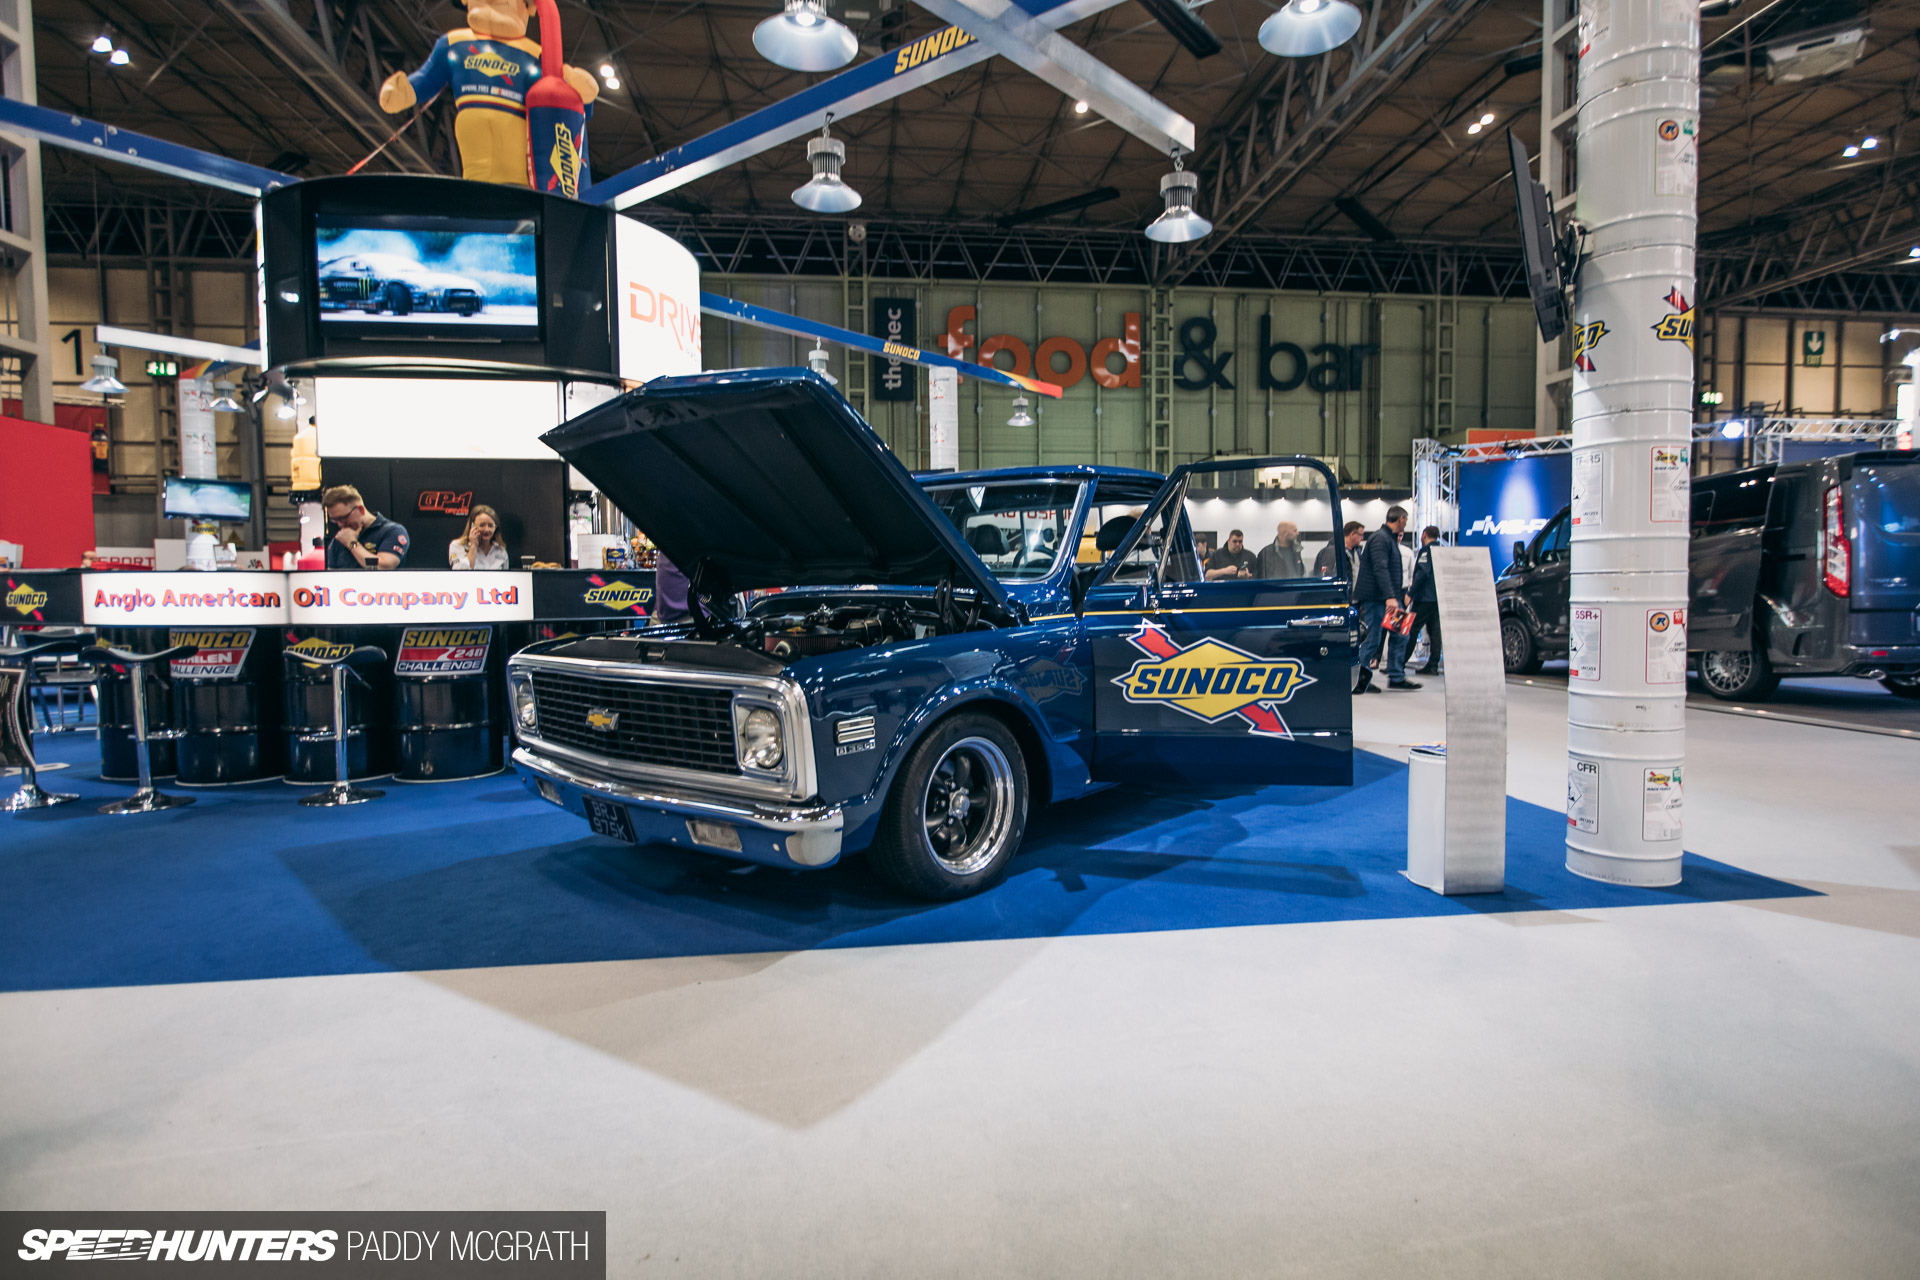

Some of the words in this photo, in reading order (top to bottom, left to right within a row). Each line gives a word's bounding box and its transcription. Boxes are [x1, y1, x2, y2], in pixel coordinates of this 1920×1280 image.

[894, 25, 976, 74] SUNOC
[466, 56, 519, 74] SUNOCO
[1574, 325, 1599, 350] CO
[61, 329, 84, 376] 1
[883, 341, 920, 360] SUNOCO
[938, 305, 1141, 388] food
[1174, 316, 1235, 391] &
[1260, 314, 1378, 392] bar
[7, 593, 46, 606] SUNOCO
[94, 588, 156, 612] Anglo
[162, 587, 281, 608] American
[293, 585, 331, 607] Oil
[338, 587, 468, 610] Company
[476, 585, 519, 605] Ltd
[587, 590, 650, 602] SUNOCO
[1575, 610, 1599, 621] 5SR+
[404, 630, 490, 647] SUNOCO
[454, 647, 483, 659] 240
[397, 660, 481, 671] CHALLENGE
[1133, 667, 1293, 695] SUNOCO
[1576, 761, 1597, 774] CFR
[590, 801, 618, 821] BRJ
[593, 817, 628, 840] 975K
